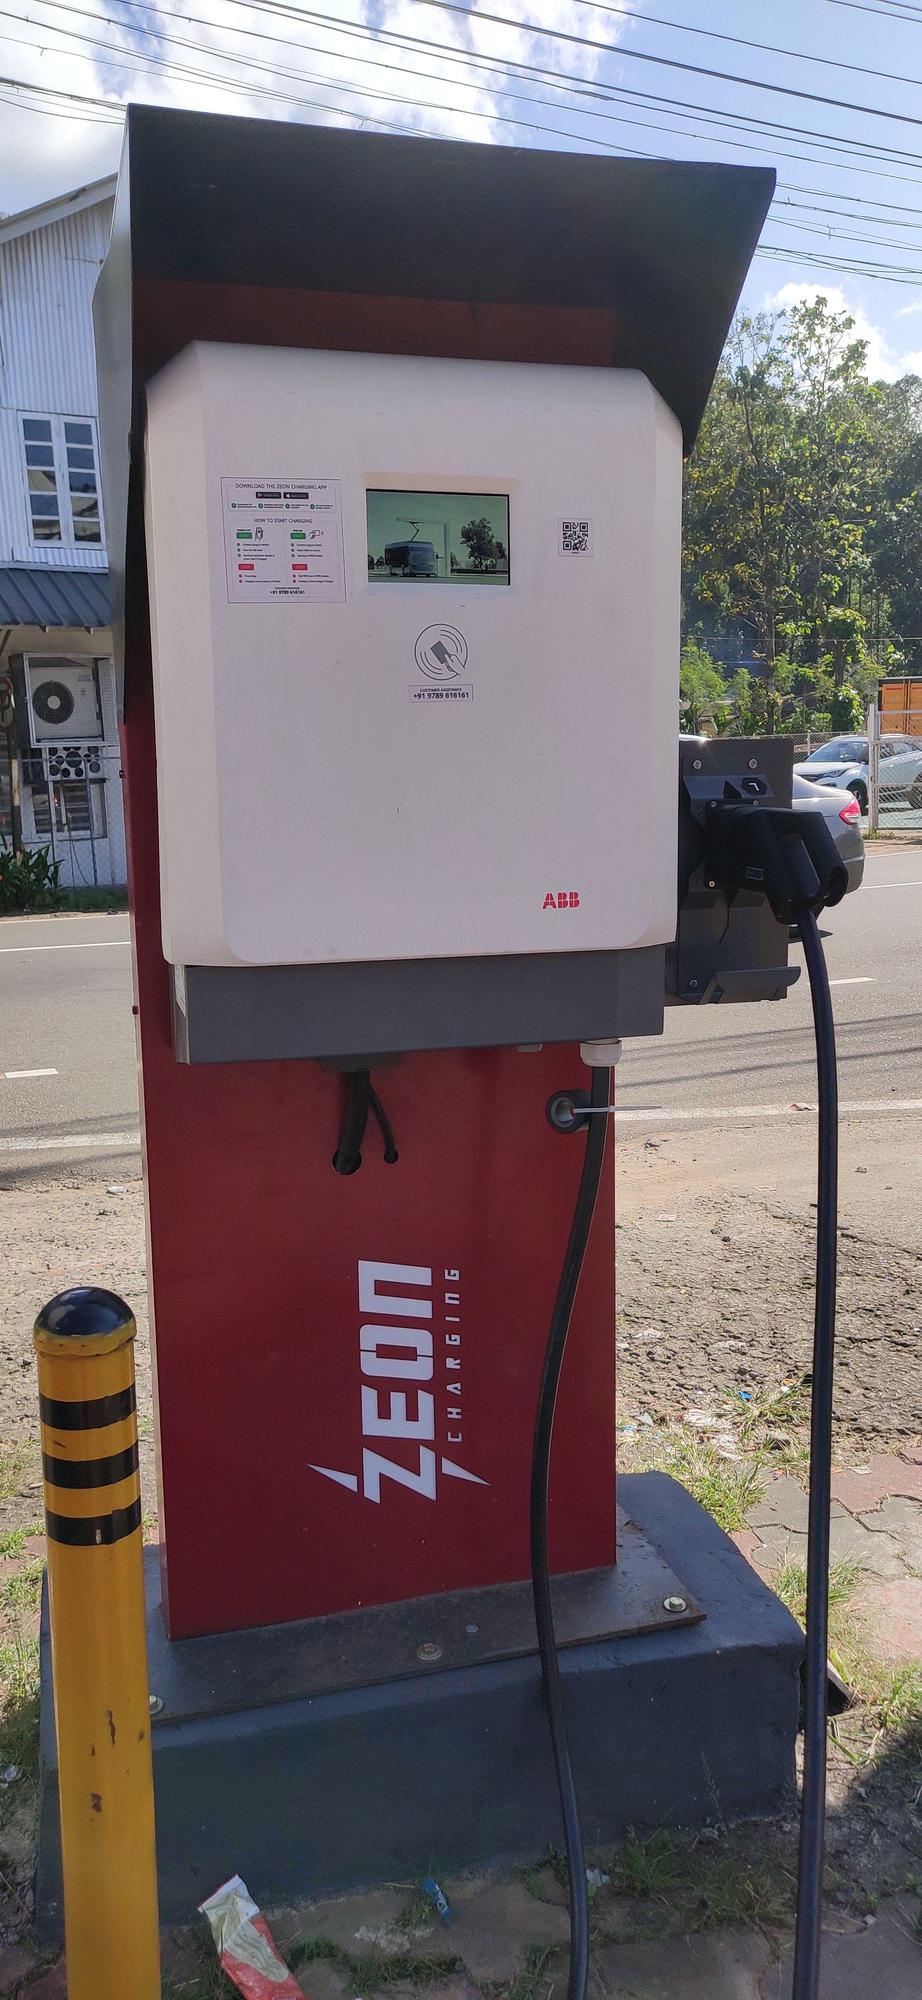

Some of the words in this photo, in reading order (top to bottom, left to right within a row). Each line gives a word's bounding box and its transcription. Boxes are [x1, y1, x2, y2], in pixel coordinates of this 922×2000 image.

[542, 891, 580, 909] ABB
[357, 1259, 437, 1504] ZEON
[444, 1268, 463, 1443] CHARGING
